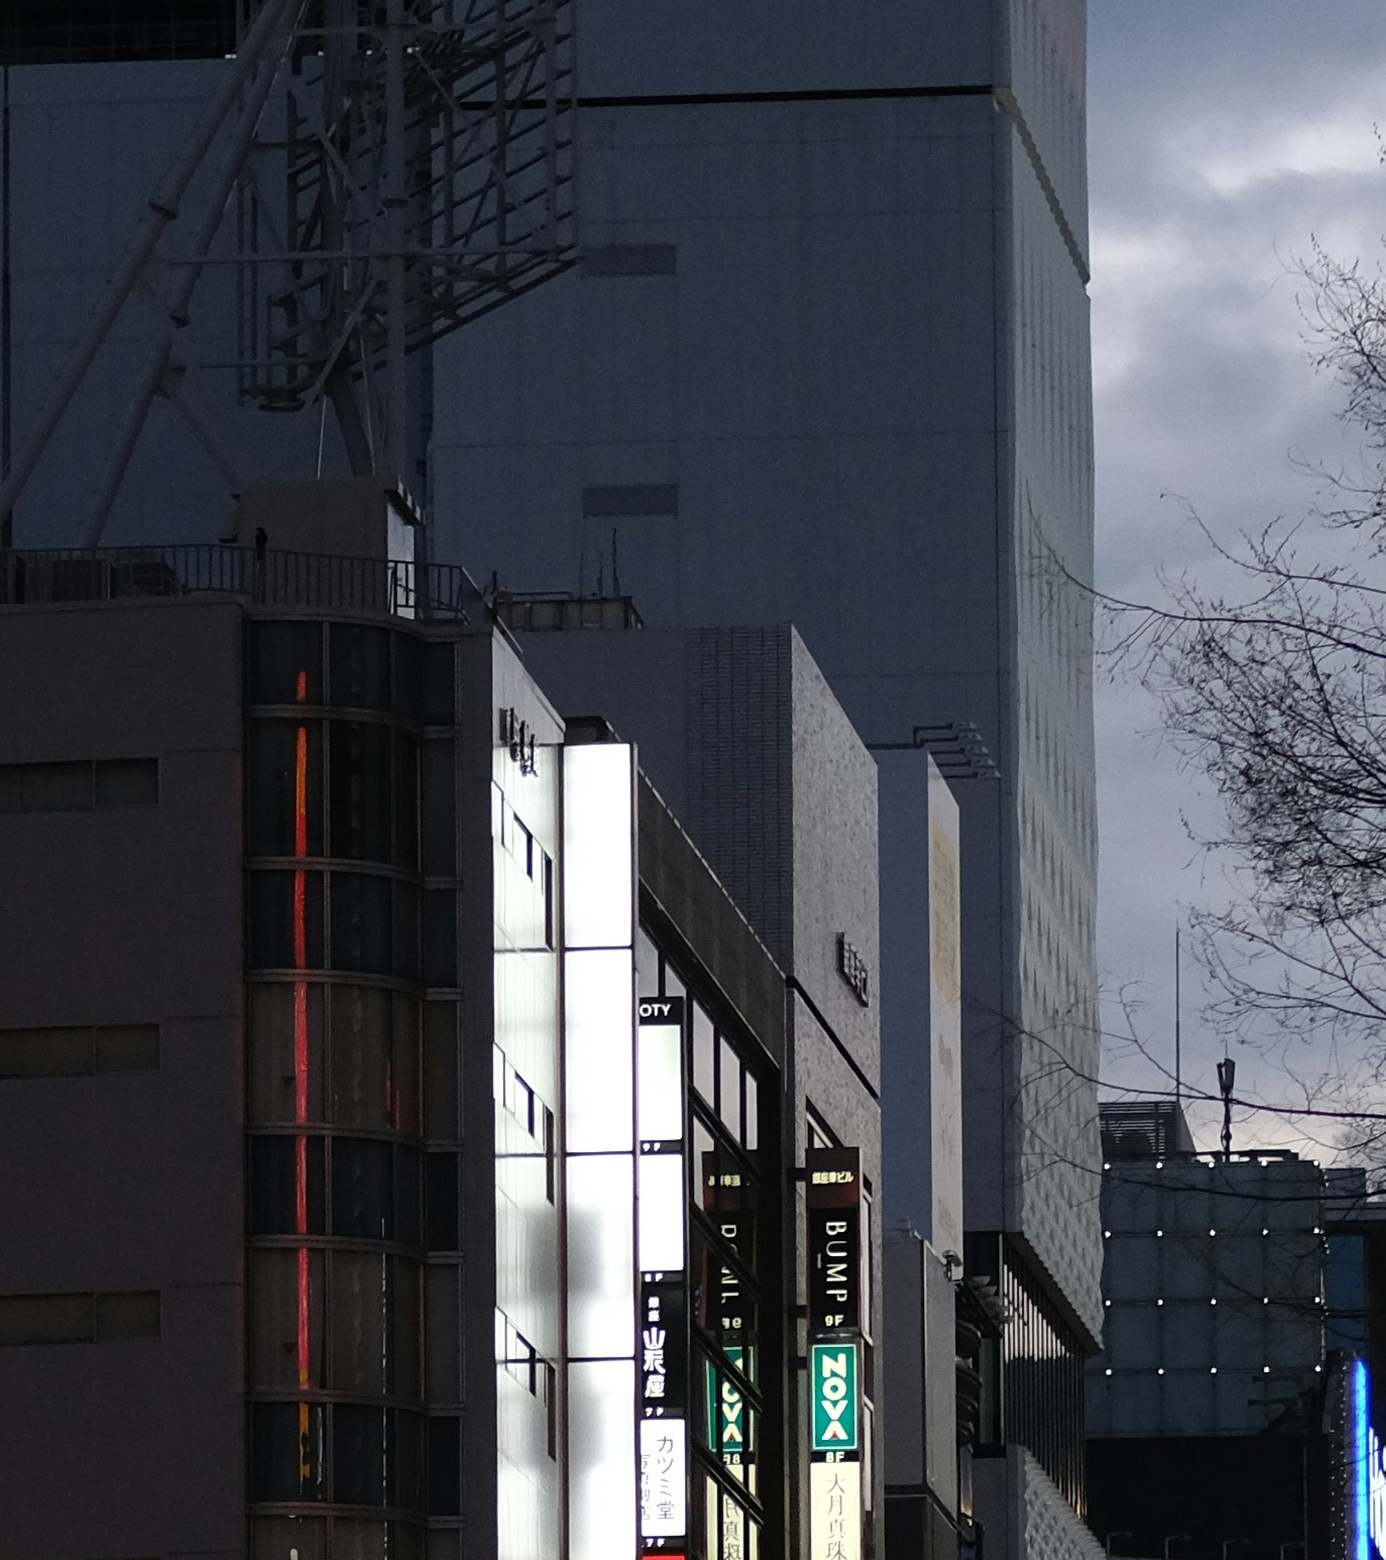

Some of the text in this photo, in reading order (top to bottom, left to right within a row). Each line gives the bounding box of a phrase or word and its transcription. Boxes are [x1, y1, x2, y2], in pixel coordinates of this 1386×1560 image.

[825, 1221, 848, 1302] BUMP
[825, 1314, 845, 1326] 9F
[643, 1327, 666, 1398] 山形屋
[821, 1353, 849, 1440] NOVA
[656, 1436, 675, 1520] カツミ堂
[826, 1452, 845, 1463] 8F
